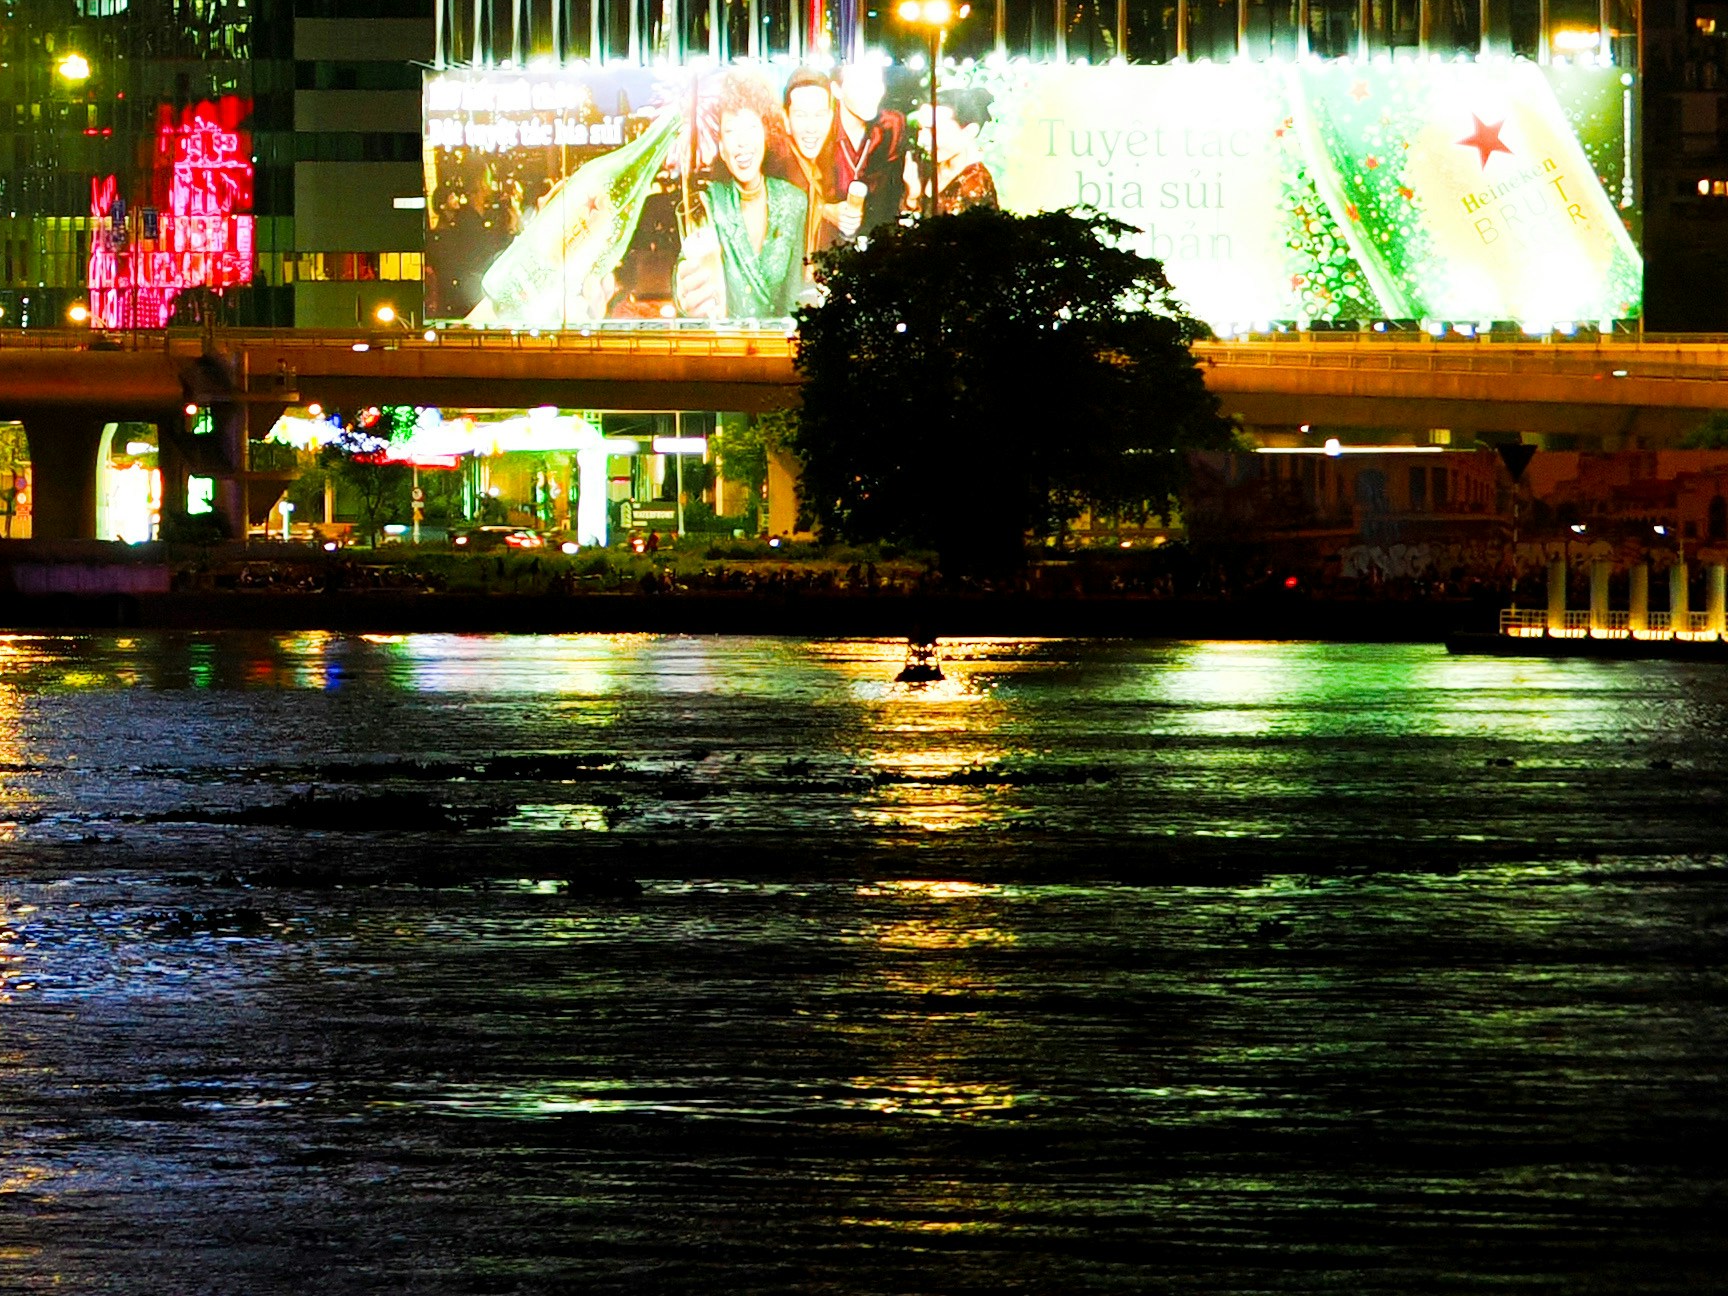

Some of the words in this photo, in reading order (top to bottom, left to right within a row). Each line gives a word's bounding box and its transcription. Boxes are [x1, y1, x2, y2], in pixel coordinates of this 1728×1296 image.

[1039, 118, 1168, 167] Tuyệt
[1183, 118, 1251, 157] tác
[1076, 171, 1144, 209] bia
[1460, 157, 1558, 215] Heineken
[1473, 175, 1568, 245] BRUT
